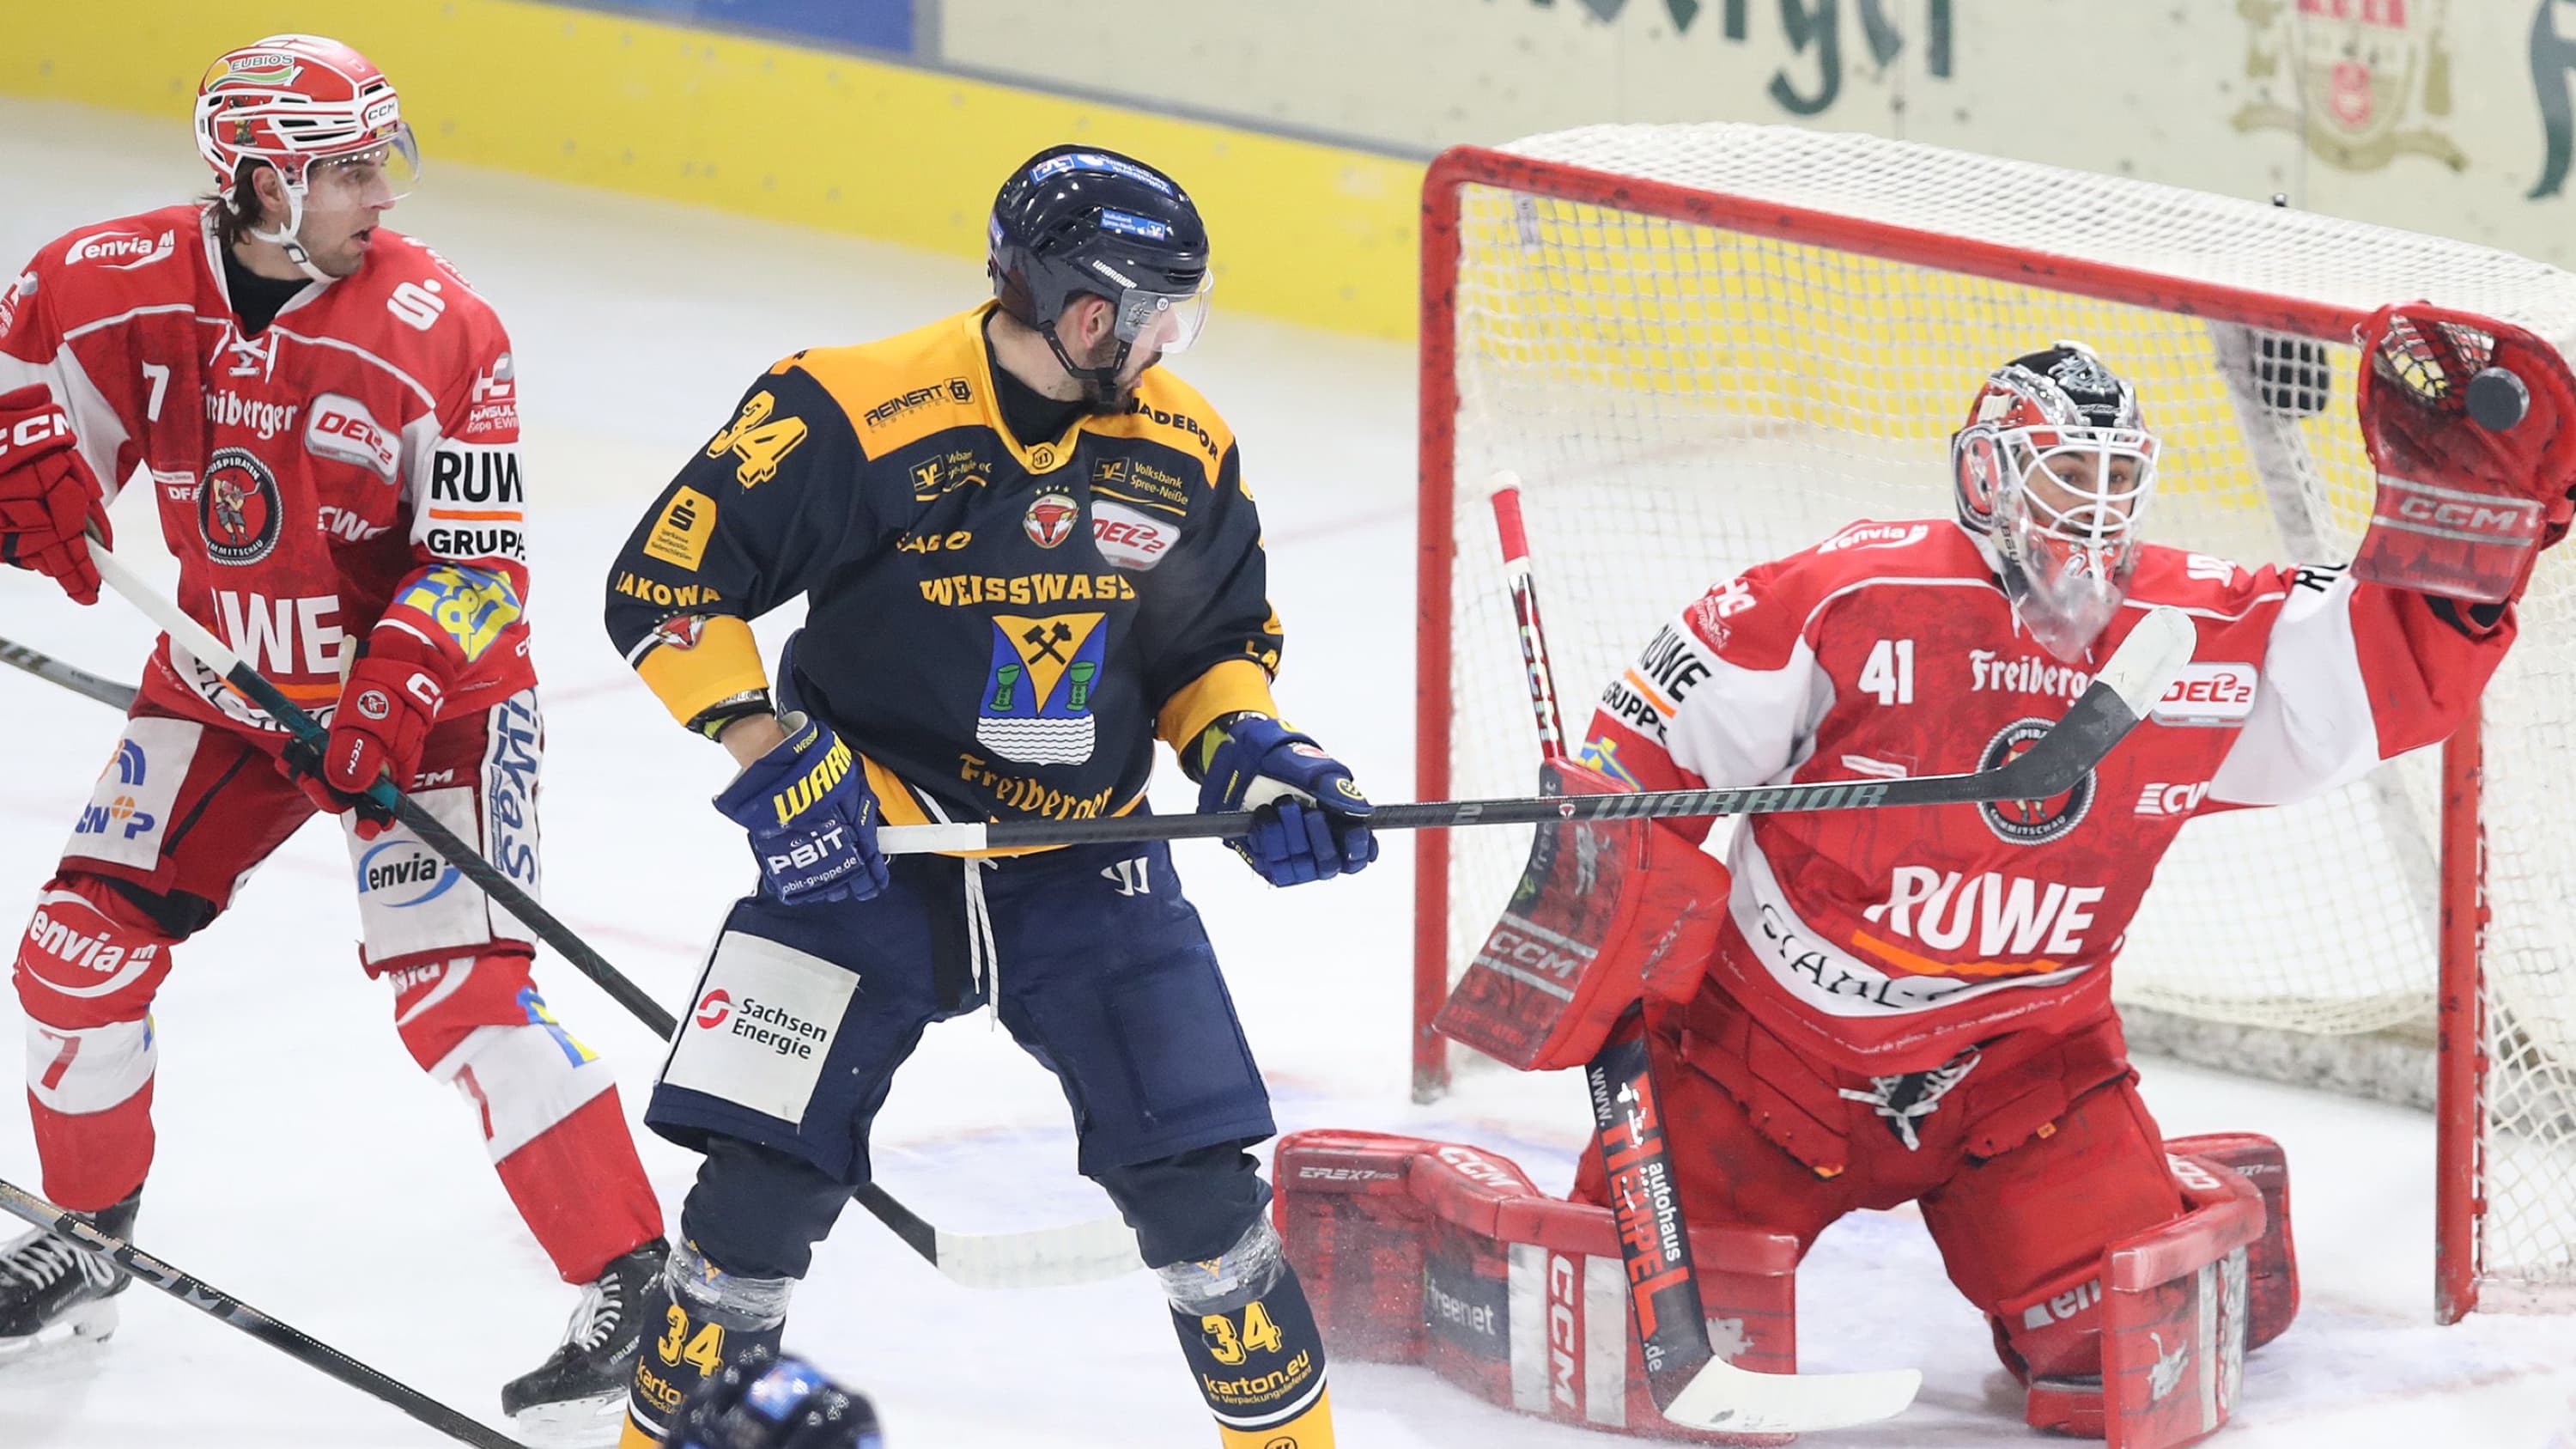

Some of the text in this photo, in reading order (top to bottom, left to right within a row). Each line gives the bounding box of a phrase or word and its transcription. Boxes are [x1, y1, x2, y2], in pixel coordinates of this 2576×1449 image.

[231, 54, 294, 71] EUBIOS
[368, 103, 396, 120] CCM
[85, 236, 153, 259] envia
[1092, 259, 1138, 290] WARRIOR
[142, 359, 170, 423] 7
[864, 384, 943, 427] REINERT
[706, 389, 808, 489] 34
[1130, 474, 1188, 505] Spree-Neiße
[1134, 461, 1183, 489] Volksbank
[2398, 495, 2518, 532] CCM
[1857, 638, 1915, 706] 41
[347, 738, 364, 775] CCM
[1592, 783, 1890, 821] WARRIOR
[368, 853, 437, 890] envia
[1862, 865, 2106, 959] RUWE
[29, 910, 126, 973] envia
[1488, 930, 1577, 979] CCM
[732, 1018, 812, 1060] Energie
[739, 998, 828, 1043] Sachsen
[39, 1029, 82, 1091] 7
[1438, 1146, 1525, 1188] CCM
[1589, 1068, 1613, 1128] www.
[1643, 1340, 1663, 1373] .de
[1648, 1161, 1682, 1262] autohaus
[1428, 1280, 1497, 1337] freenet
[657, 1303, 726, 1380] 34
[1201, 1300, 1283, 1366] 34
[1551, 1254, 1577, 1411] CCM
[1202, 1349, 1310, 1396] karton.eu
